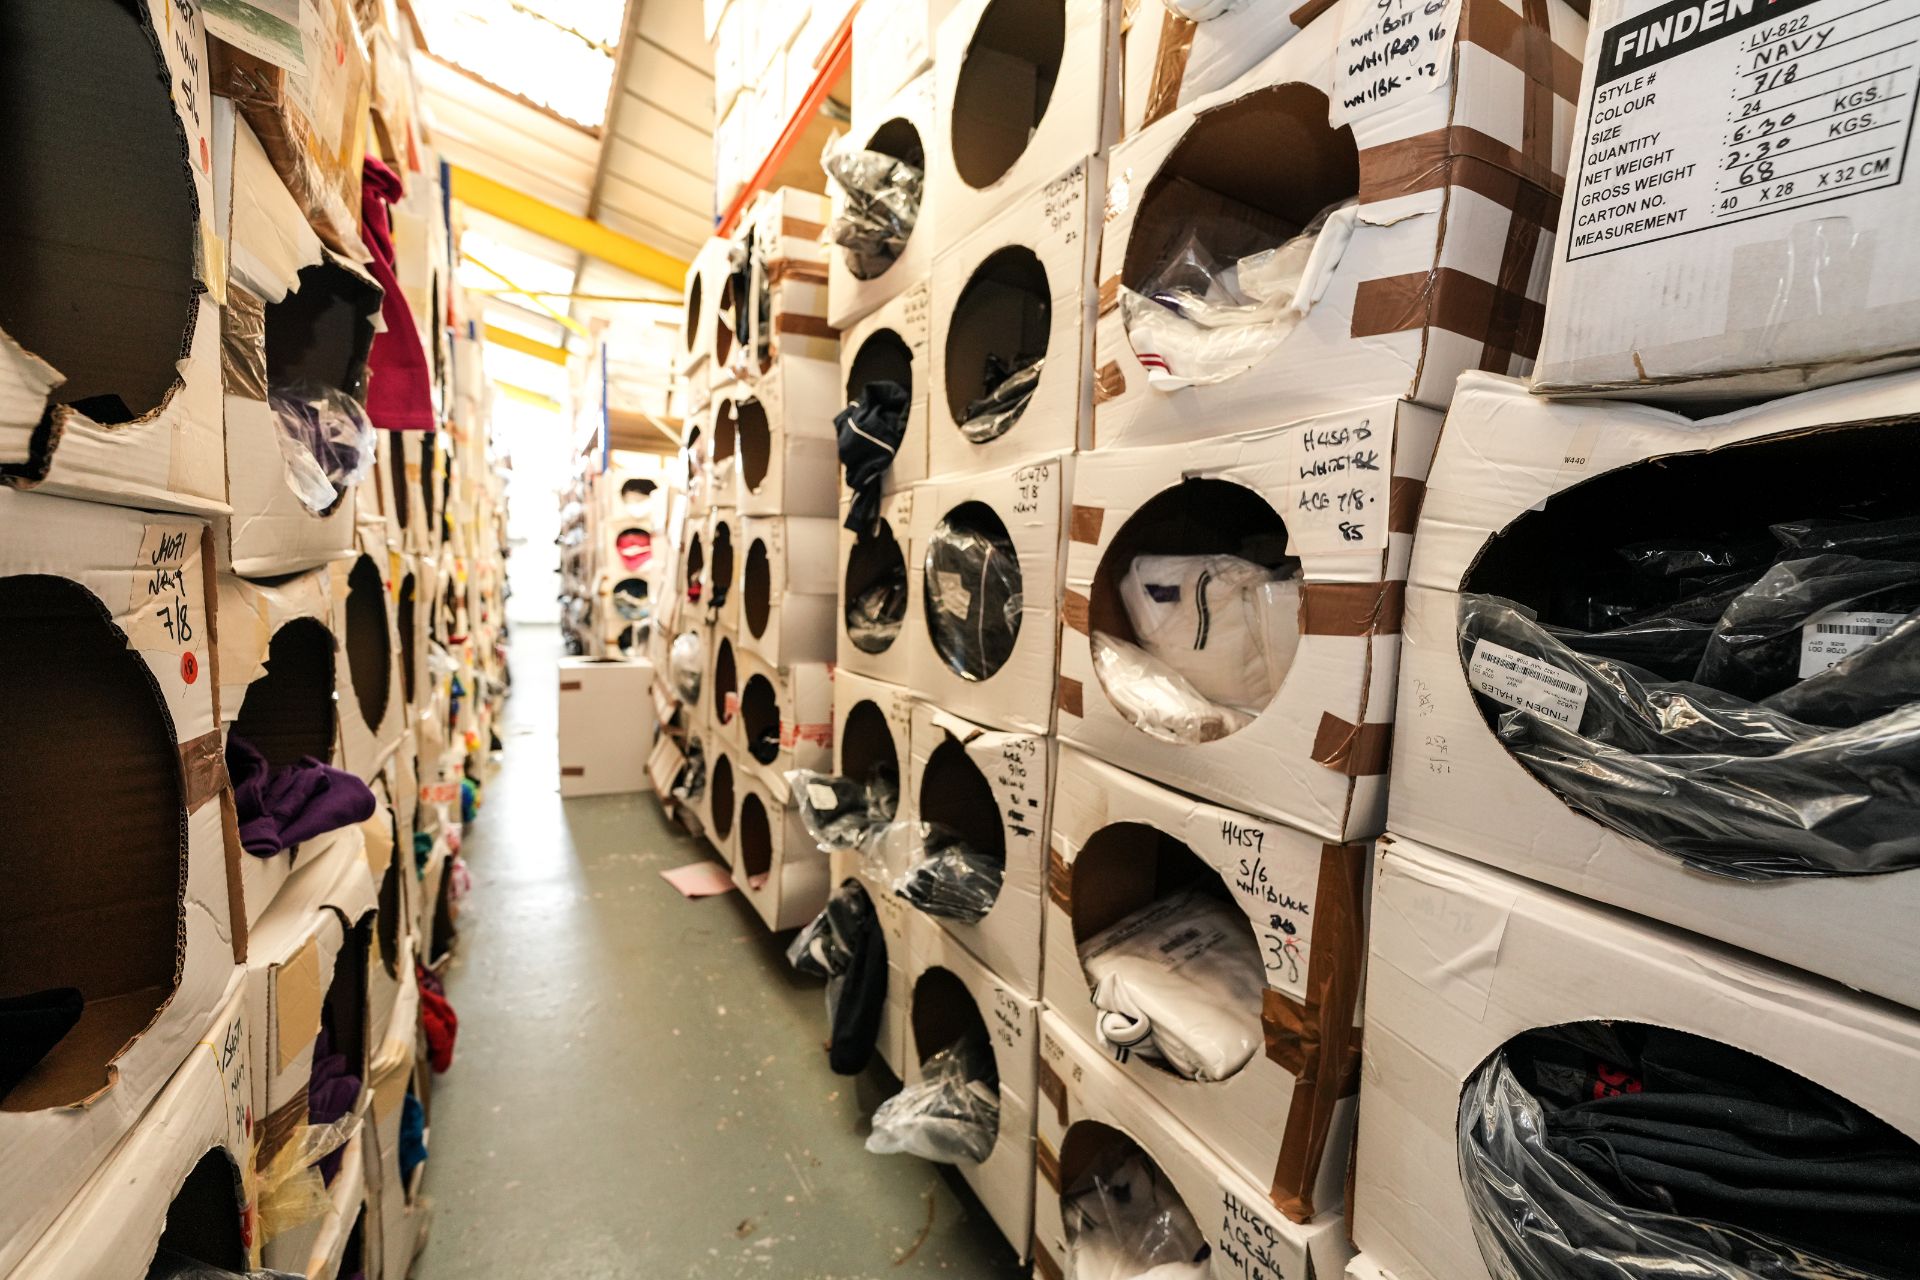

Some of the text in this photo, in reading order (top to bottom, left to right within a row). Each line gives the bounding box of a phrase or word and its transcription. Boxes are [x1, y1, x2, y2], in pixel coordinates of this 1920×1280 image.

[1614, 0, 1756, 67] FINDEN
[1752, 26, 1835, 71] NAVY
[1598, 14, 1810, 104] STYLE # LV-822
[1754, 62, 1799, 94] 7/8
[1594, 93, 1656, 125] COLOUR
[1588, 100, 1761, 166] QUANTITY 24
[1591, 125, 1623, 146] SIZE
[1584, 149, 1675, 187] NET WEIGHT
[1739, 161, 1774, 185] 68
[1581, 163, 1696, 207] GROSS WEIGHT
[1575, 157, 1891, 247] MEASUREMENT 40 X 28 X 32 CM
[1578, 194, 1667, 227] CARTON NO.
[157, 596, 192, 645] 7/8
[1481, 682, 1513, 702] HALES
[1516, 696, 1524, 705] &
[1525, 702, 1569, 722] FINDEN
[1222, 821, 1265, 854] H459
